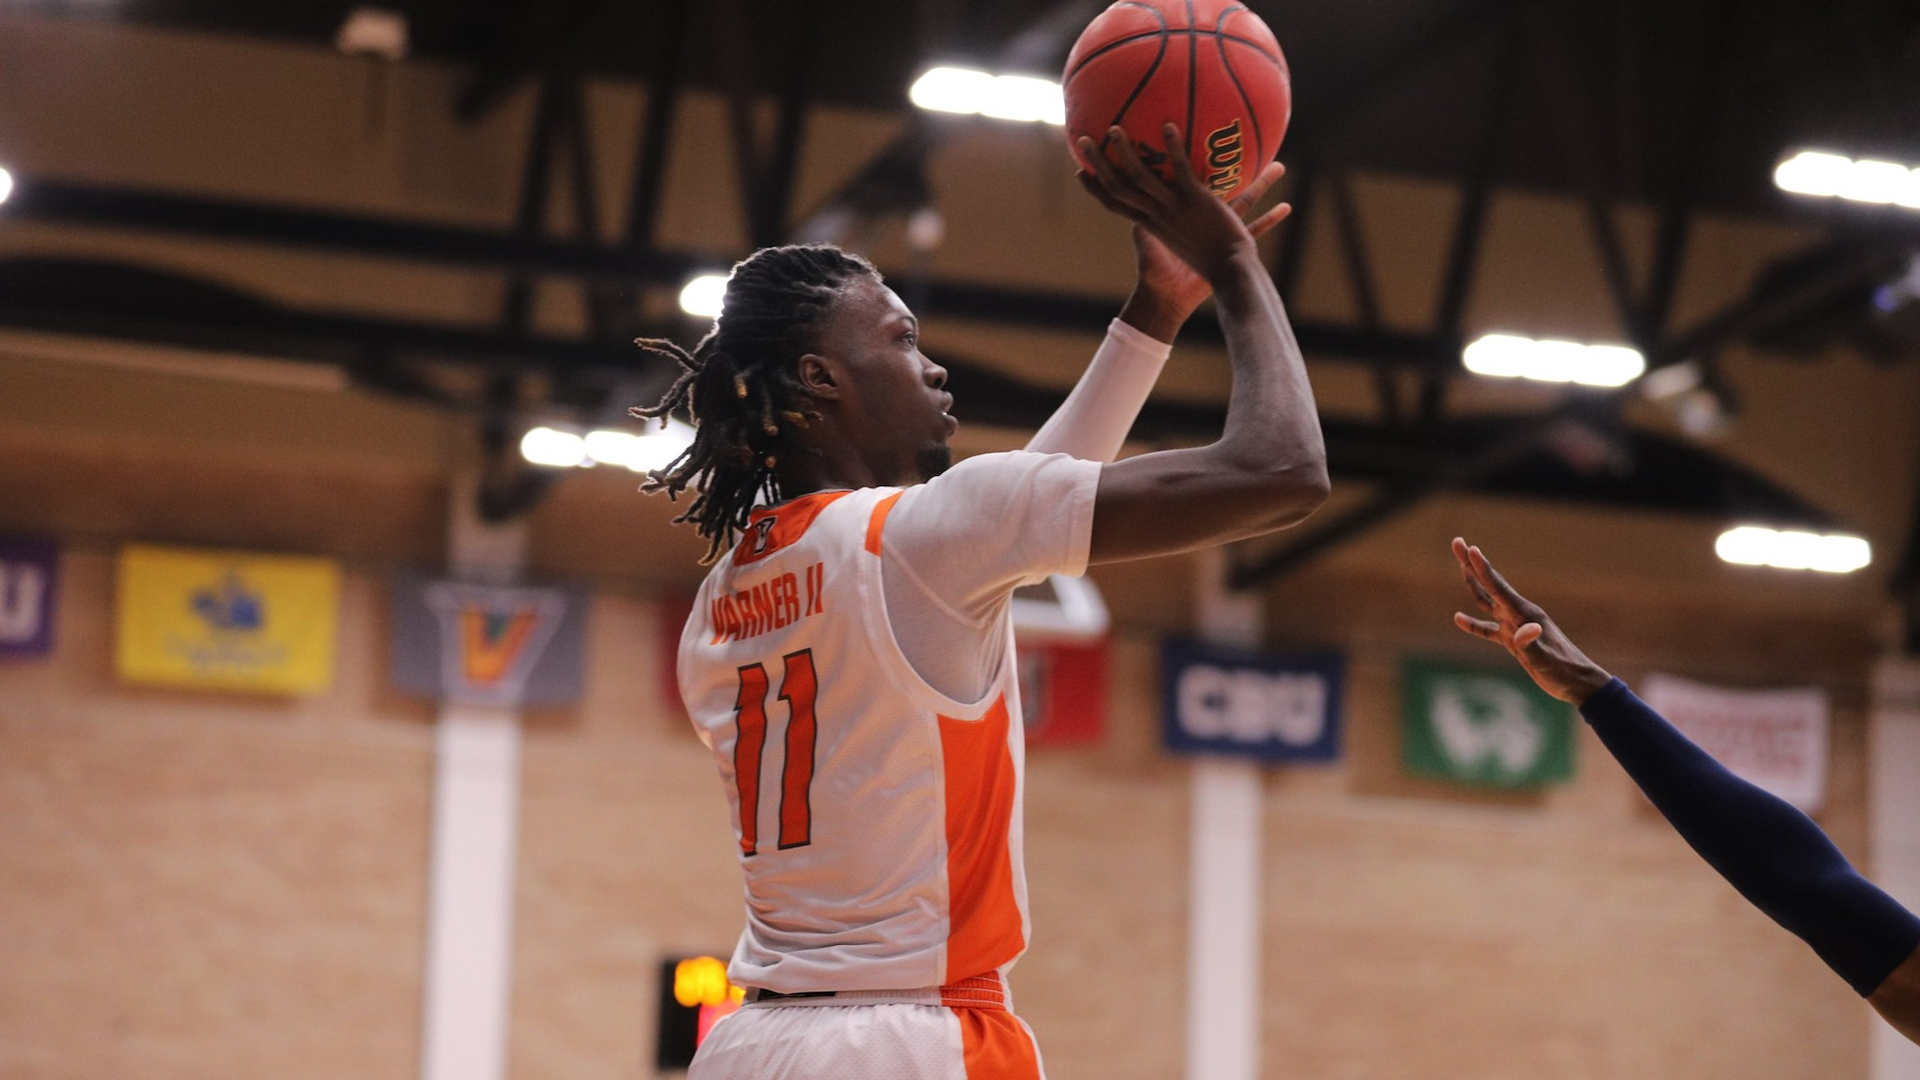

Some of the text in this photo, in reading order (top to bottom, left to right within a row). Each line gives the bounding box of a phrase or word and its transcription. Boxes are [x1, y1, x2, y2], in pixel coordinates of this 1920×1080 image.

[1205, 118, 1243, 194] Wil
[710, 562, 825, 645] VARNER II
[734, 647, 818, 857] 11
